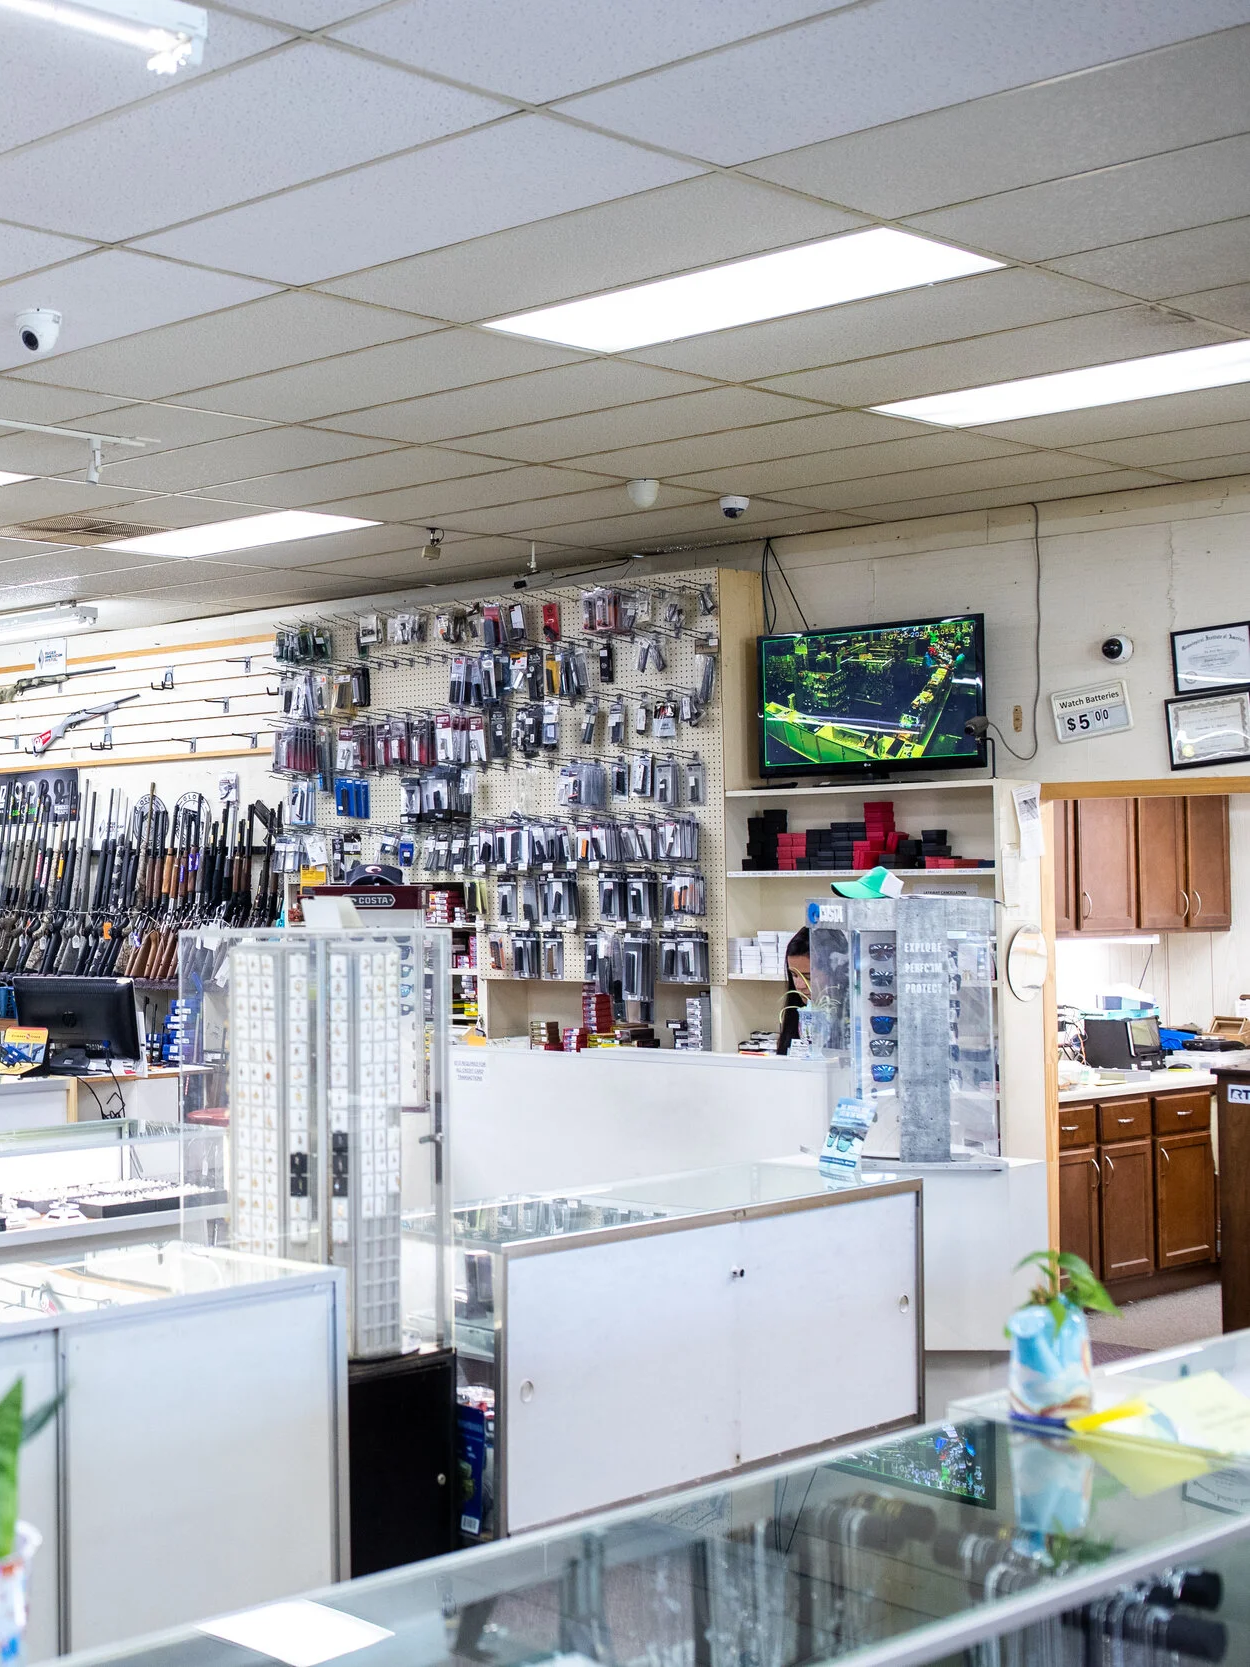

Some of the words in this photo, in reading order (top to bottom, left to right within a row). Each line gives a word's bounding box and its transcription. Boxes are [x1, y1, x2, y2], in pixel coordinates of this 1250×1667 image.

[1059, 698, 1084, 709] Watch
[1085, 691, 1120, 704] Batteries
[358, 896, 388, 904] COSTA
[904, 943, 943, 953] EXPLORE
[905, 983, 943, 994] PROTECT
